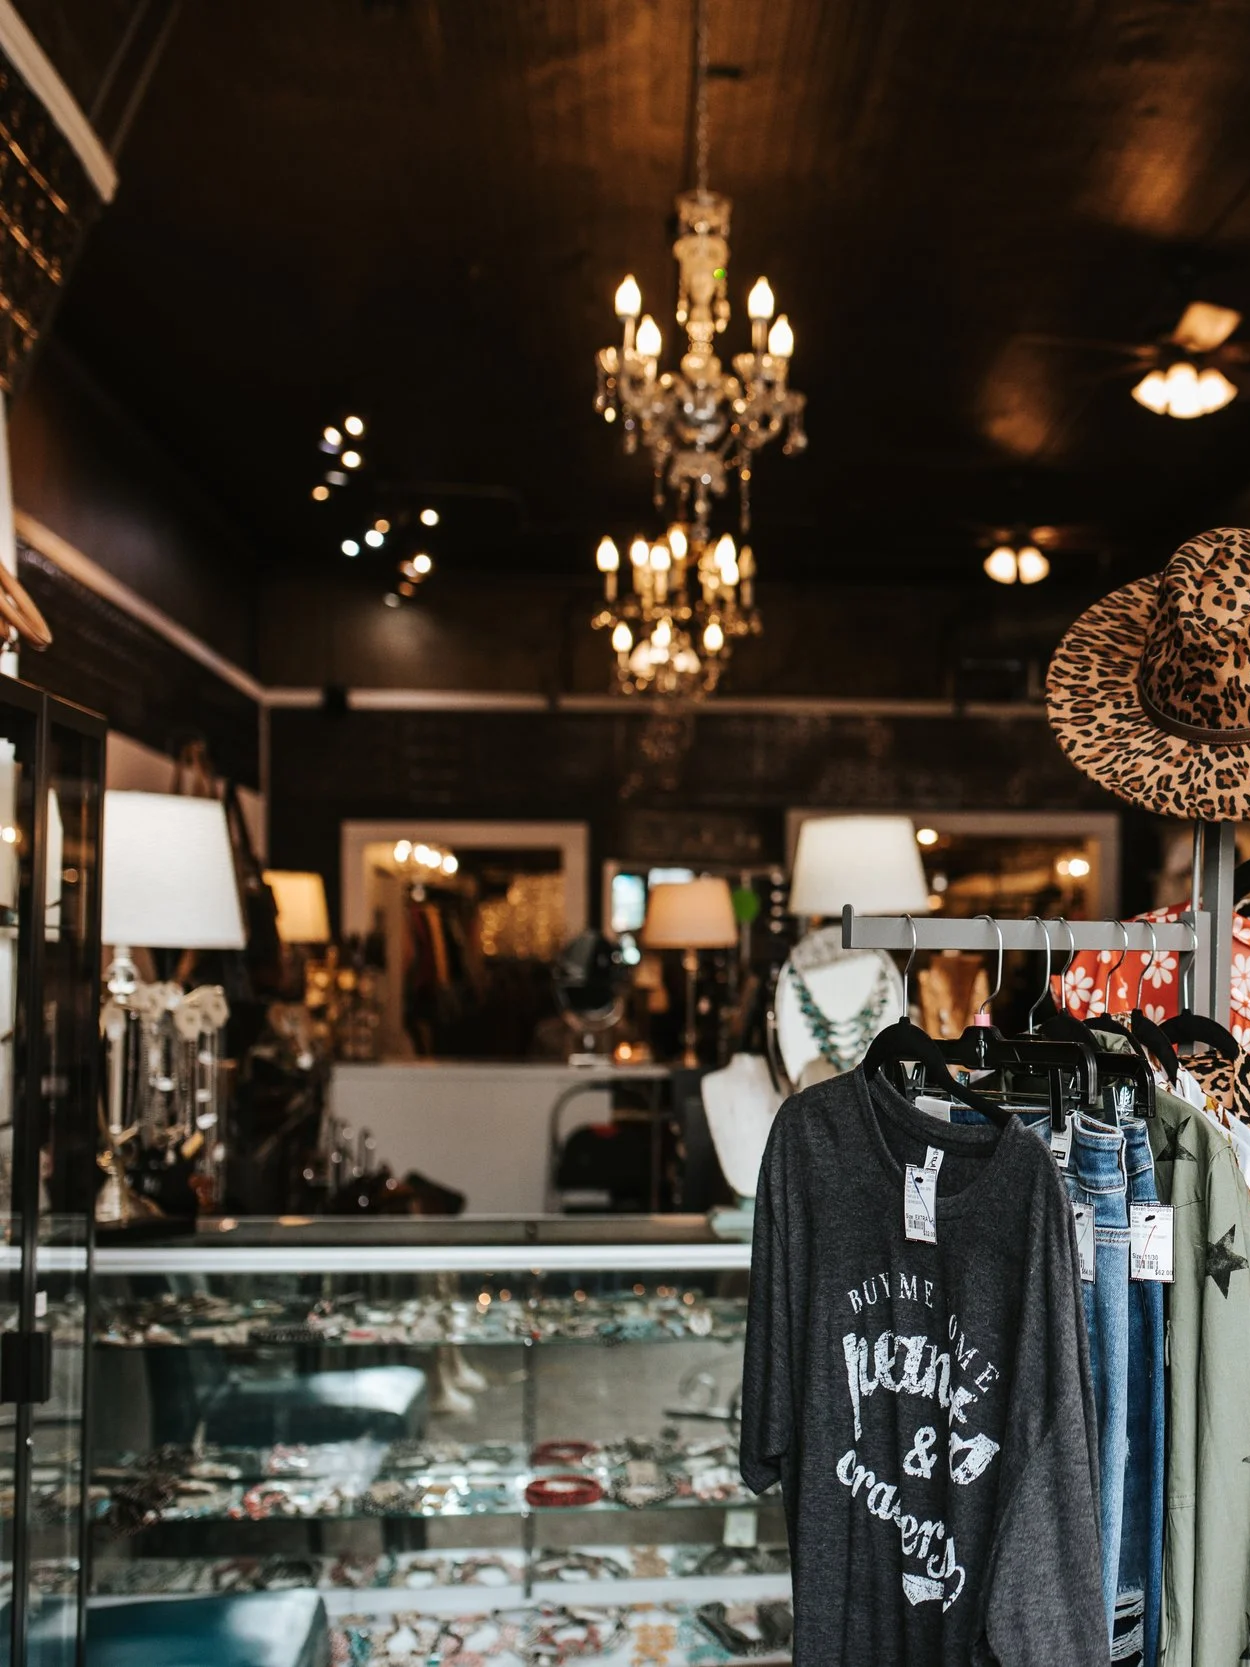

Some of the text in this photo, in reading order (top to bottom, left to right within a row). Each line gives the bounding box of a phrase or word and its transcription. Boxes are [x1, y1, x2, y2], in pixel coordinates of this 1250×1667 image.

[848, 1272, 1001, 1394] BUY ME OME
